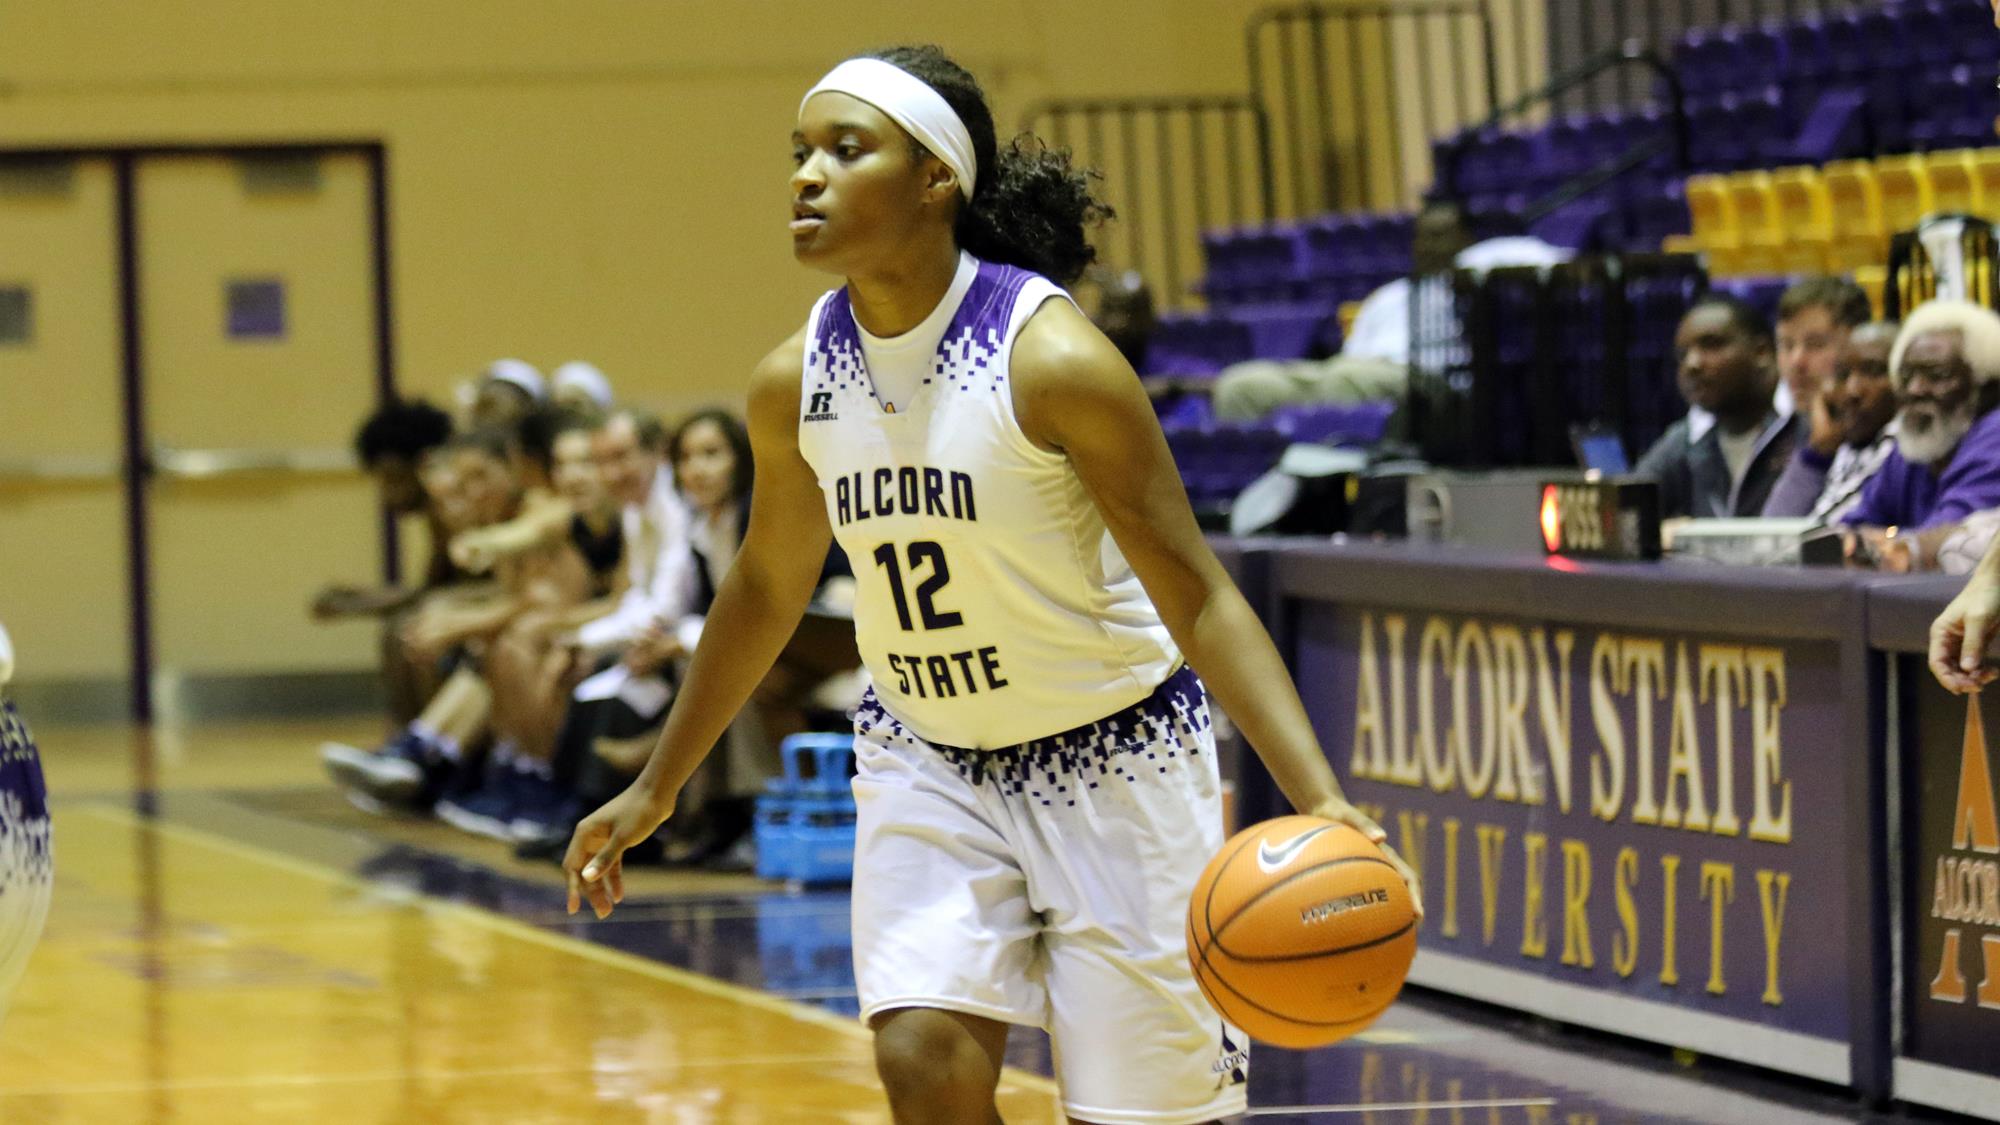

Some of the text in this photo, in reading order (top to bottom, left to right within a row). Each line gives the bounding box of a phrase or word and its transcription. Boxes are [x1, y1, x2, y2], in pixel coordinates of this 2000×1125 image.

[804, 413, 839, 422] RUSSELL
[837, 467, 977, 526] ALCORN
[873, 541, 964, 631] 12
[888, 646, 1009, 699] STATE
[1351, 613, 1794, 843] ALCORN STATE
[1931, 854, 2000, 927] ALCOR
